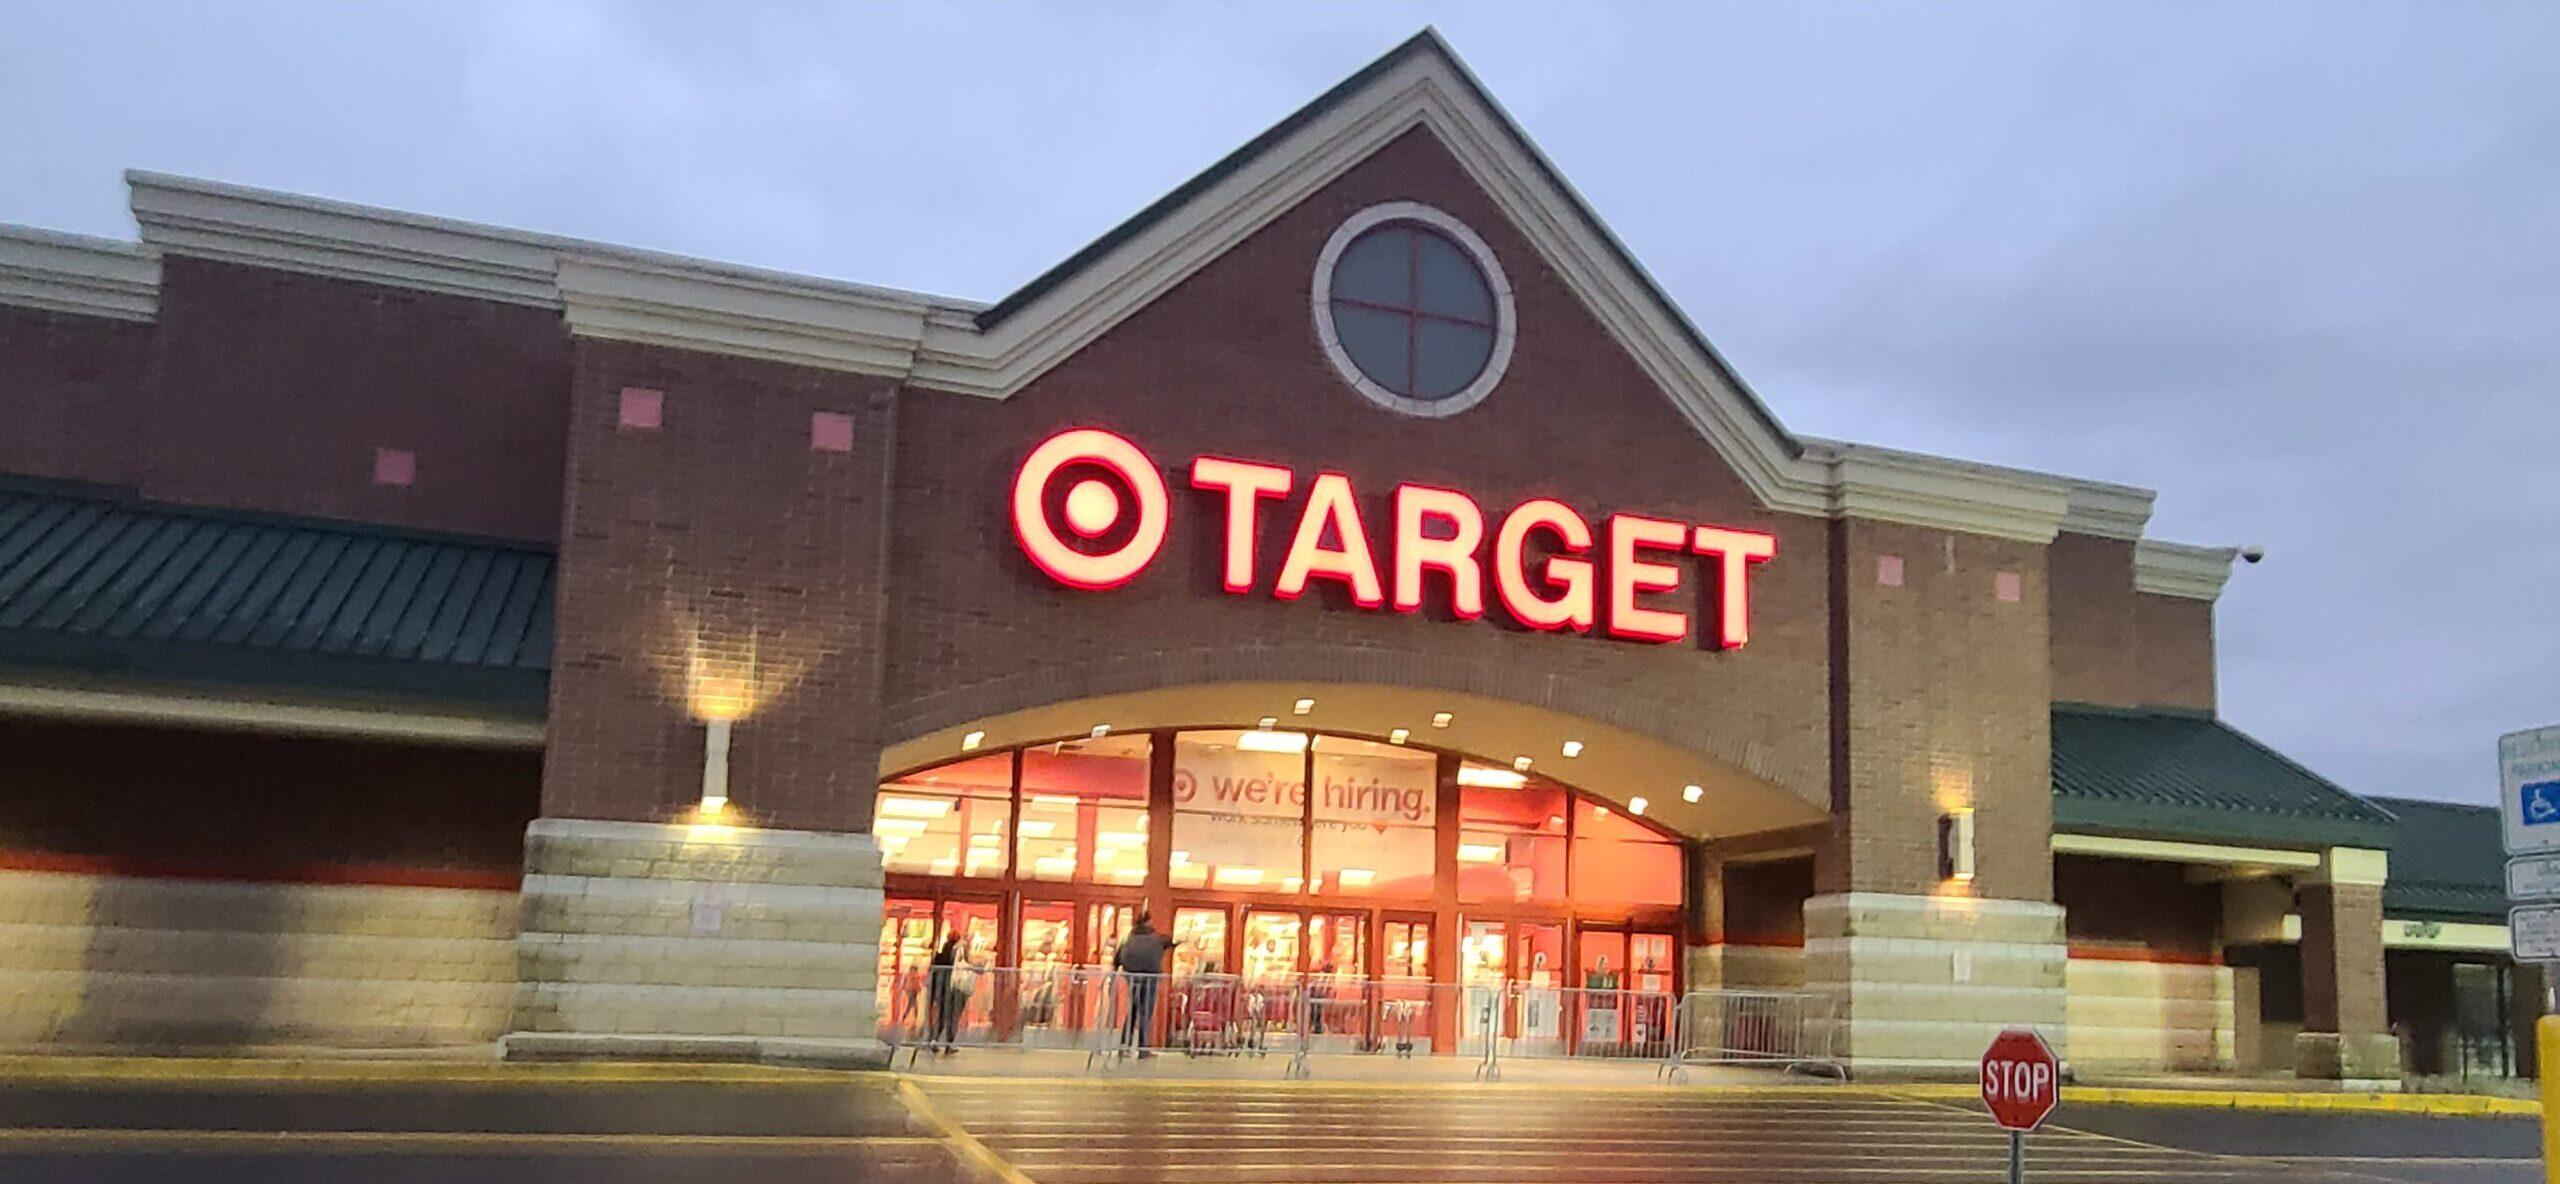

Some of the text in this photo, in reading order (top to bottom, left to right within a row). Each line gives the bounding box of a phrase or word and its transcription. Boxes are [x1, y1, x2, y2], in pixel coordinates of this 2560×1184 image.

[1191, 455, 1777, 649] TARGET
[1211, 771, 1431, 821] we're hiring.
[1985, 1059, 2050, 1103] STOP
